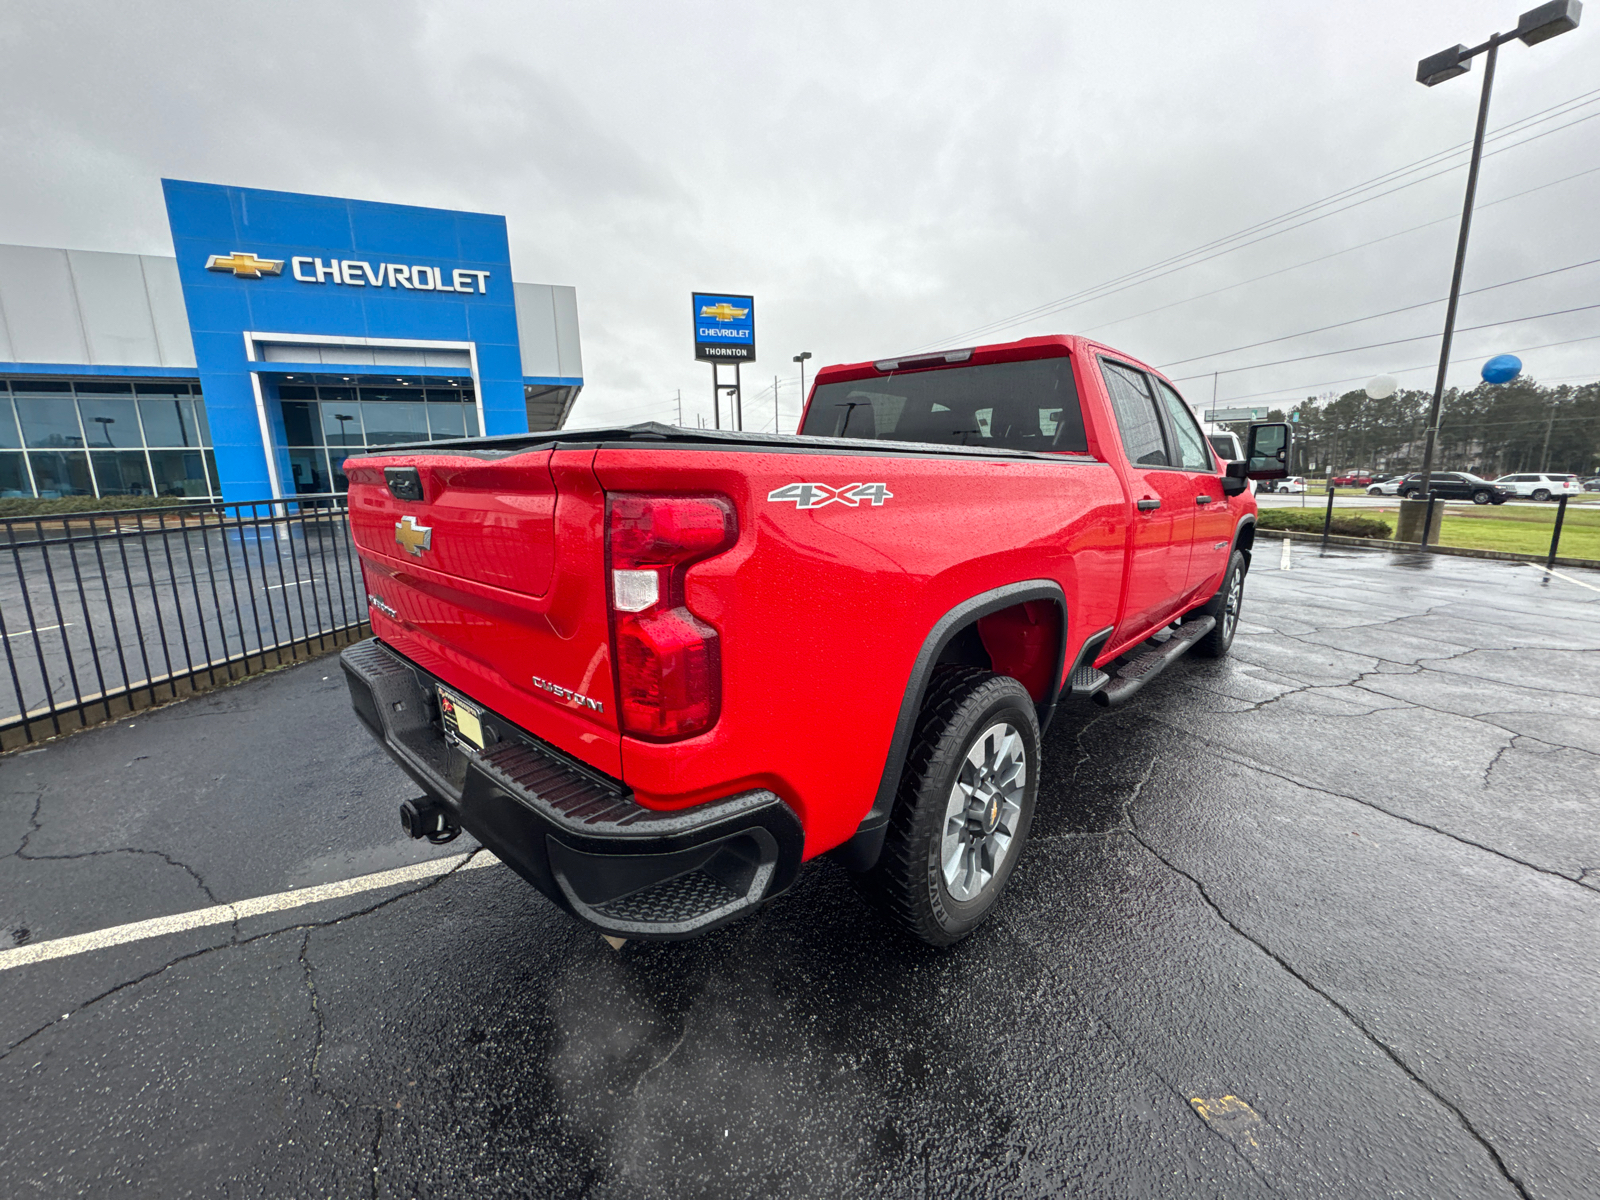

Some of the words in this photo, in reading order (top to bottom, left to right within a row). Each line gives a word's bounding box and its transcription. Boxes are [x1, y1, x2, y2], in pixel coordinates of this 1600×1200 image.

[292, 256, 490, 295] CHEVROLET
[699, 327, 750, 338] CHEVROLET
[704, 347, 747, 357] THORNTON
[532, 675, 604, 713] CUSTOM
